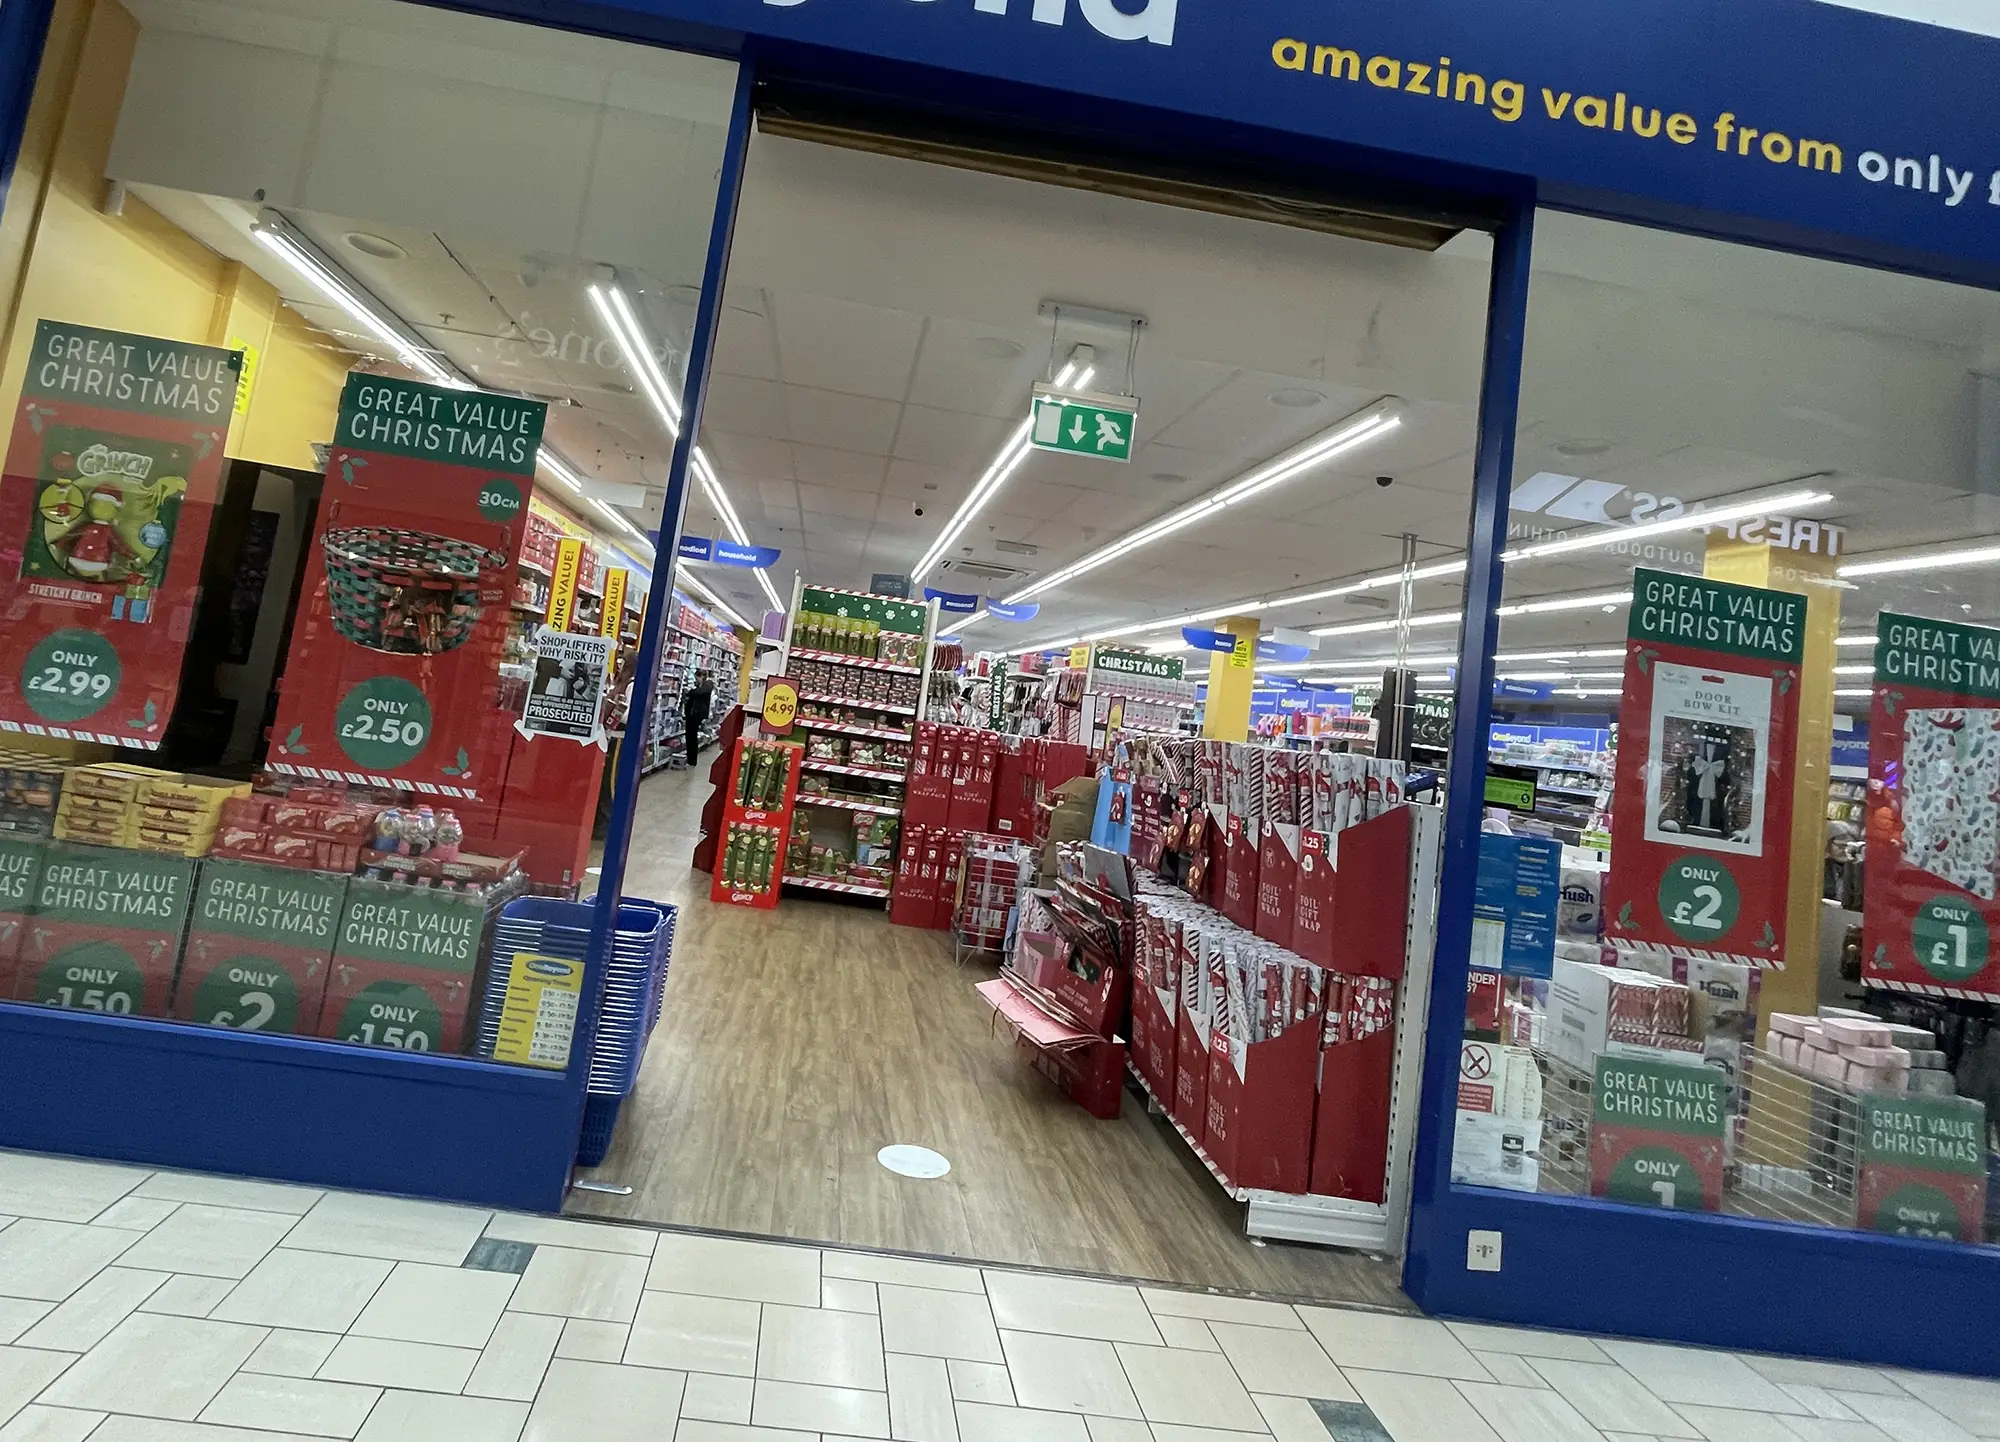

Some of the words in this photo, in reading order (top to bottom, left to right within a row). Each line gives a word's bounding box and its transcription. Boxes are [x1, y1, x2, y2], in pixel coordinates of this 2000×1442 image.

[1271, 37, 1525, 122] amazing
[1541, 88, 1697, 144] value
[1713, 111, 1844, 174] from
[1857, 150, 1974, 207] only
[48, 334, 135, 369] GREAT
[147, 350, 228, 384] VALUE
[40, 362, 222, 415] CHRISTMAS
[358, 386, 442, 419] GREAT
[453, 400, 532, 434] VALUE
[351, 412, 527, 464] CHRISTMAS
[479, 491, 520, 509] 30CM
[558, 550, 575, 595] VALUE!
[552, 598, 567, 633] ZING
[1646, 581, 1719, 612] GREAT
[1727, 594, 1796, 626] VALUE
[540, 635, 606, 654] SHOPLIFTERS
[1642, 606, 1794, 654] CHRISTMAS
[1889, 624, 1960, 655] GREAT
[1968, 636, 2000, 661] VA
[51, 650, 98, 668] ONLY
[540, 646, 562, 658] WHY
[564, 650, 587, 662] RISK
[590, 653, 604, 664] IT?
[1098, 656, 1168, 676] CHRISTMAS
[1886, 649, 2000, 689] CHRISTM
[28, 668, 112, 699] £2.99
[1694, 690, 1732, 704] DOOR
[363, 697, 409, 717] ONLY
[528, 705, 592, 723] PROSECUTED
[1683, 699, 1713, 711] BOW
[1718, 703, 1741, 716] KIT
[341, 717, 424, 746] £2.50
[46, 864, 110, 887] GREAT
[117, 871, 179, 895] VALUE
[1681, 866, 1720, 882] ONLY
[41, 886, 174, 918] CHRISTMAS
[210, 878, 270, 904] GREAT
[277, 889, 335, 915] VALUE
[1671, 885, 1723, 930] £2
[204, 898, 330, 937] CHRISTMAS
[351, 903, 411, 921] GREAT
[417, 912, 473, 937] VALUE
[1931, 906, 1970, 922] ONLY
[346, 923, 470, 959] CHRISTMAS
[1930, 924, 1968, 968] £1
[66, 966, 120, 985] ONLY
[228, 968, 280, 988] ONLY
[370, 1003, 419, 1024] ONLY
[1603, 1071, 1659, 1095] GREAT
[1665, 1079, 1717, 1102] VALUE
[1603, 1091, 1718, 1124] CHRISTMAS
[1872, 1110, 1922, 1133] GREAT
[1927, 1118, 1976, 1141] VALUE
[1871, 1130, 1978, 1163] CHRISTMAS
[1634, 1160, 1681, 1178] ONLY
[1897, 1207, 1941, 1225] ONLY
